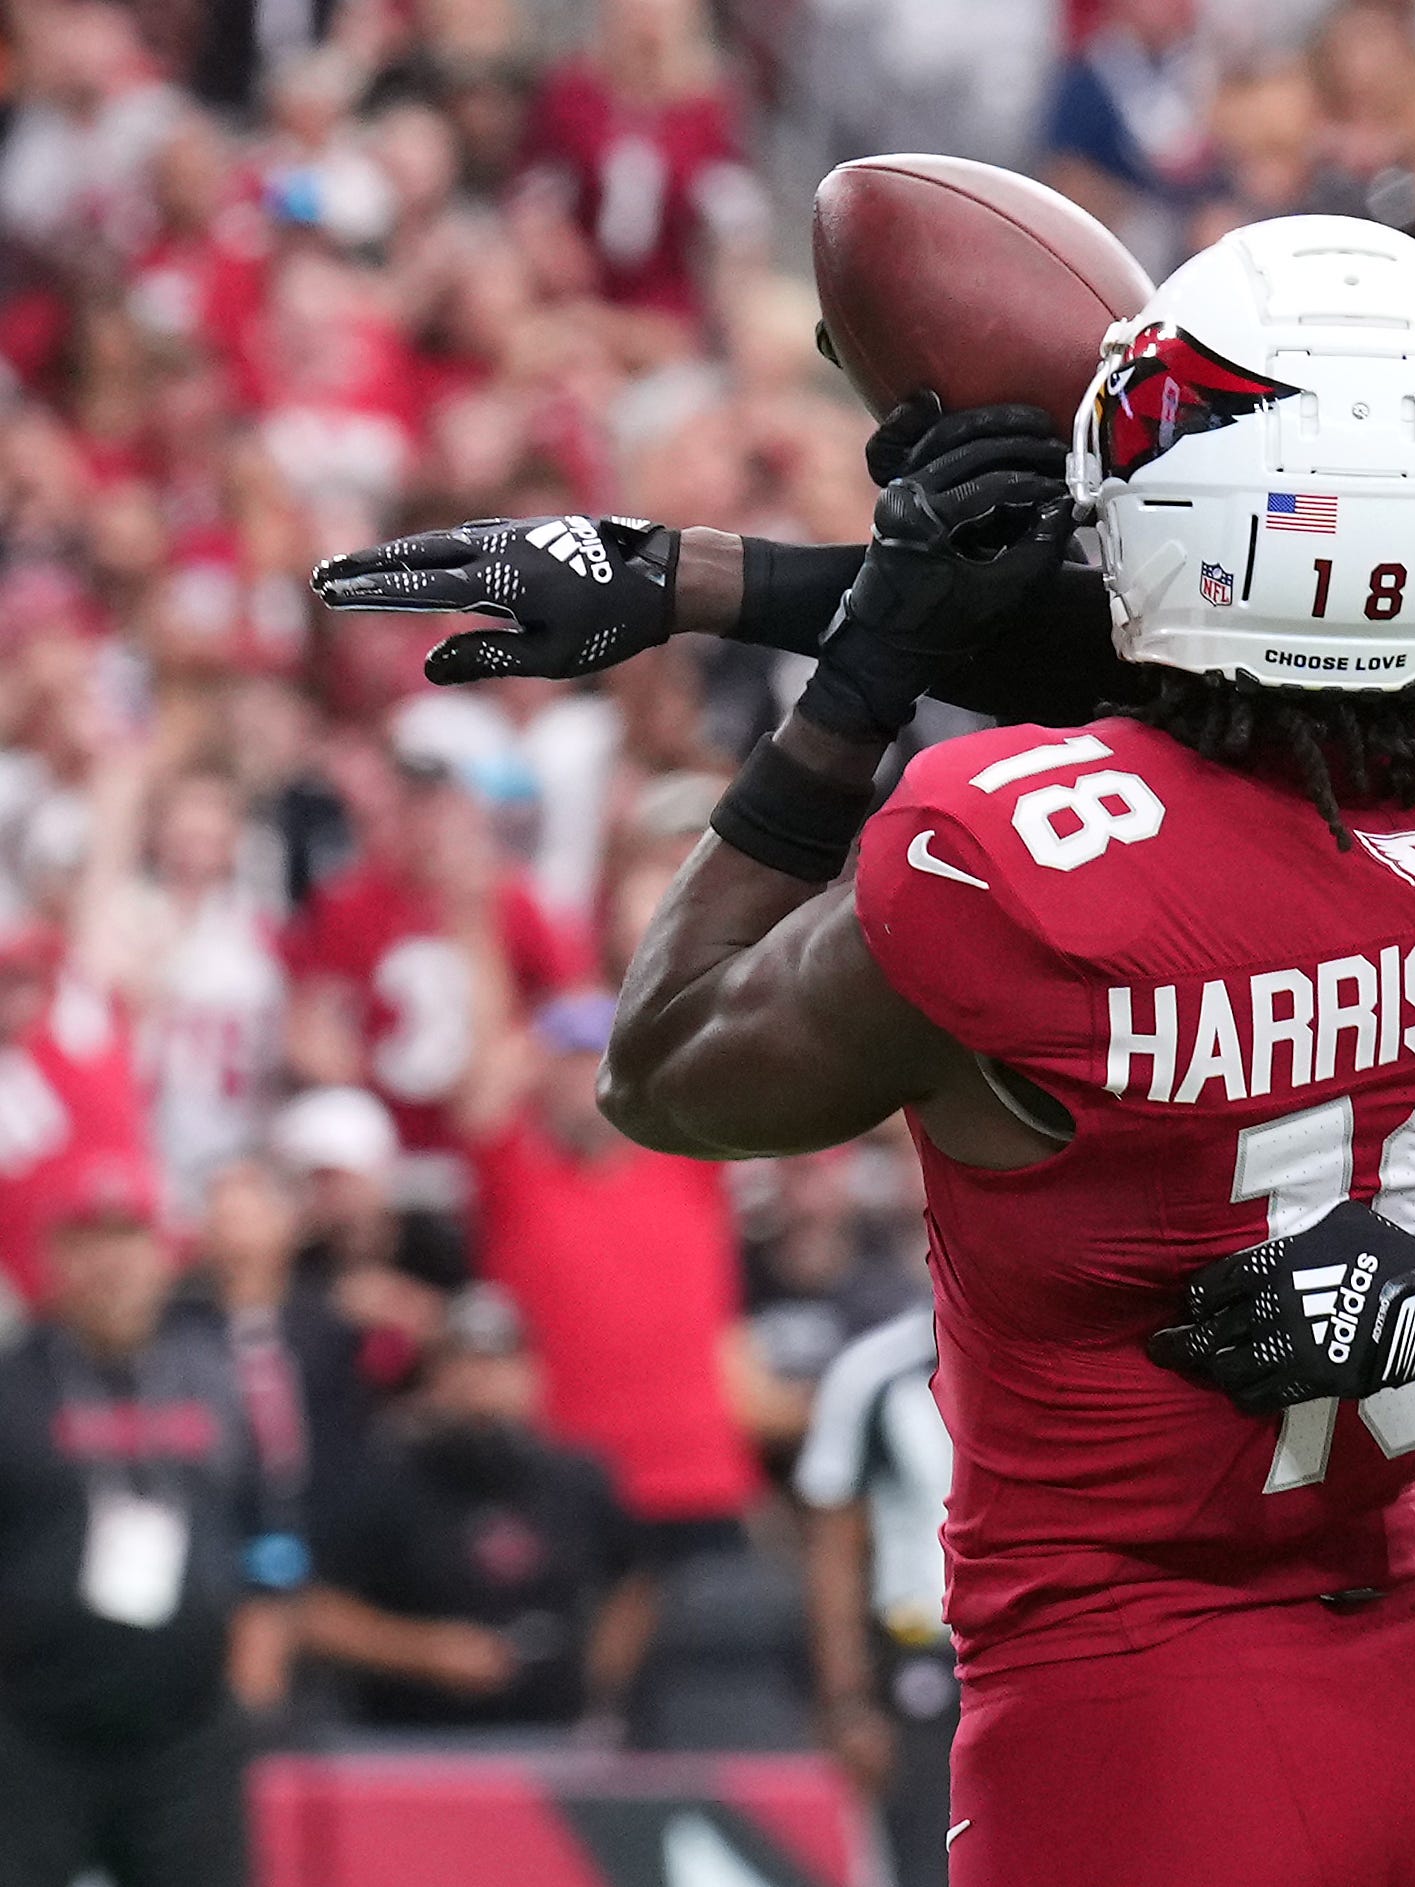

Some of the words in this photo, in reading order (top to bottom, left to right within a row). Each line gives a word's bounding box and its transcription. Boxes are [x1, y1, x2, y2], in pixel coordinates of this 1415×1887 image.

[564, 515, 613, 584] adida
[1203, 577, 1230, 604] NFL
[1312, 559, 1407, 620] 18
[1265, 649, 1348, 671] CHOOSE
[1356, 654, 1407, 671] LOVE
[968, 734, 1166, 871] 18
[1328, 1252, 1379, 1364] adidas
